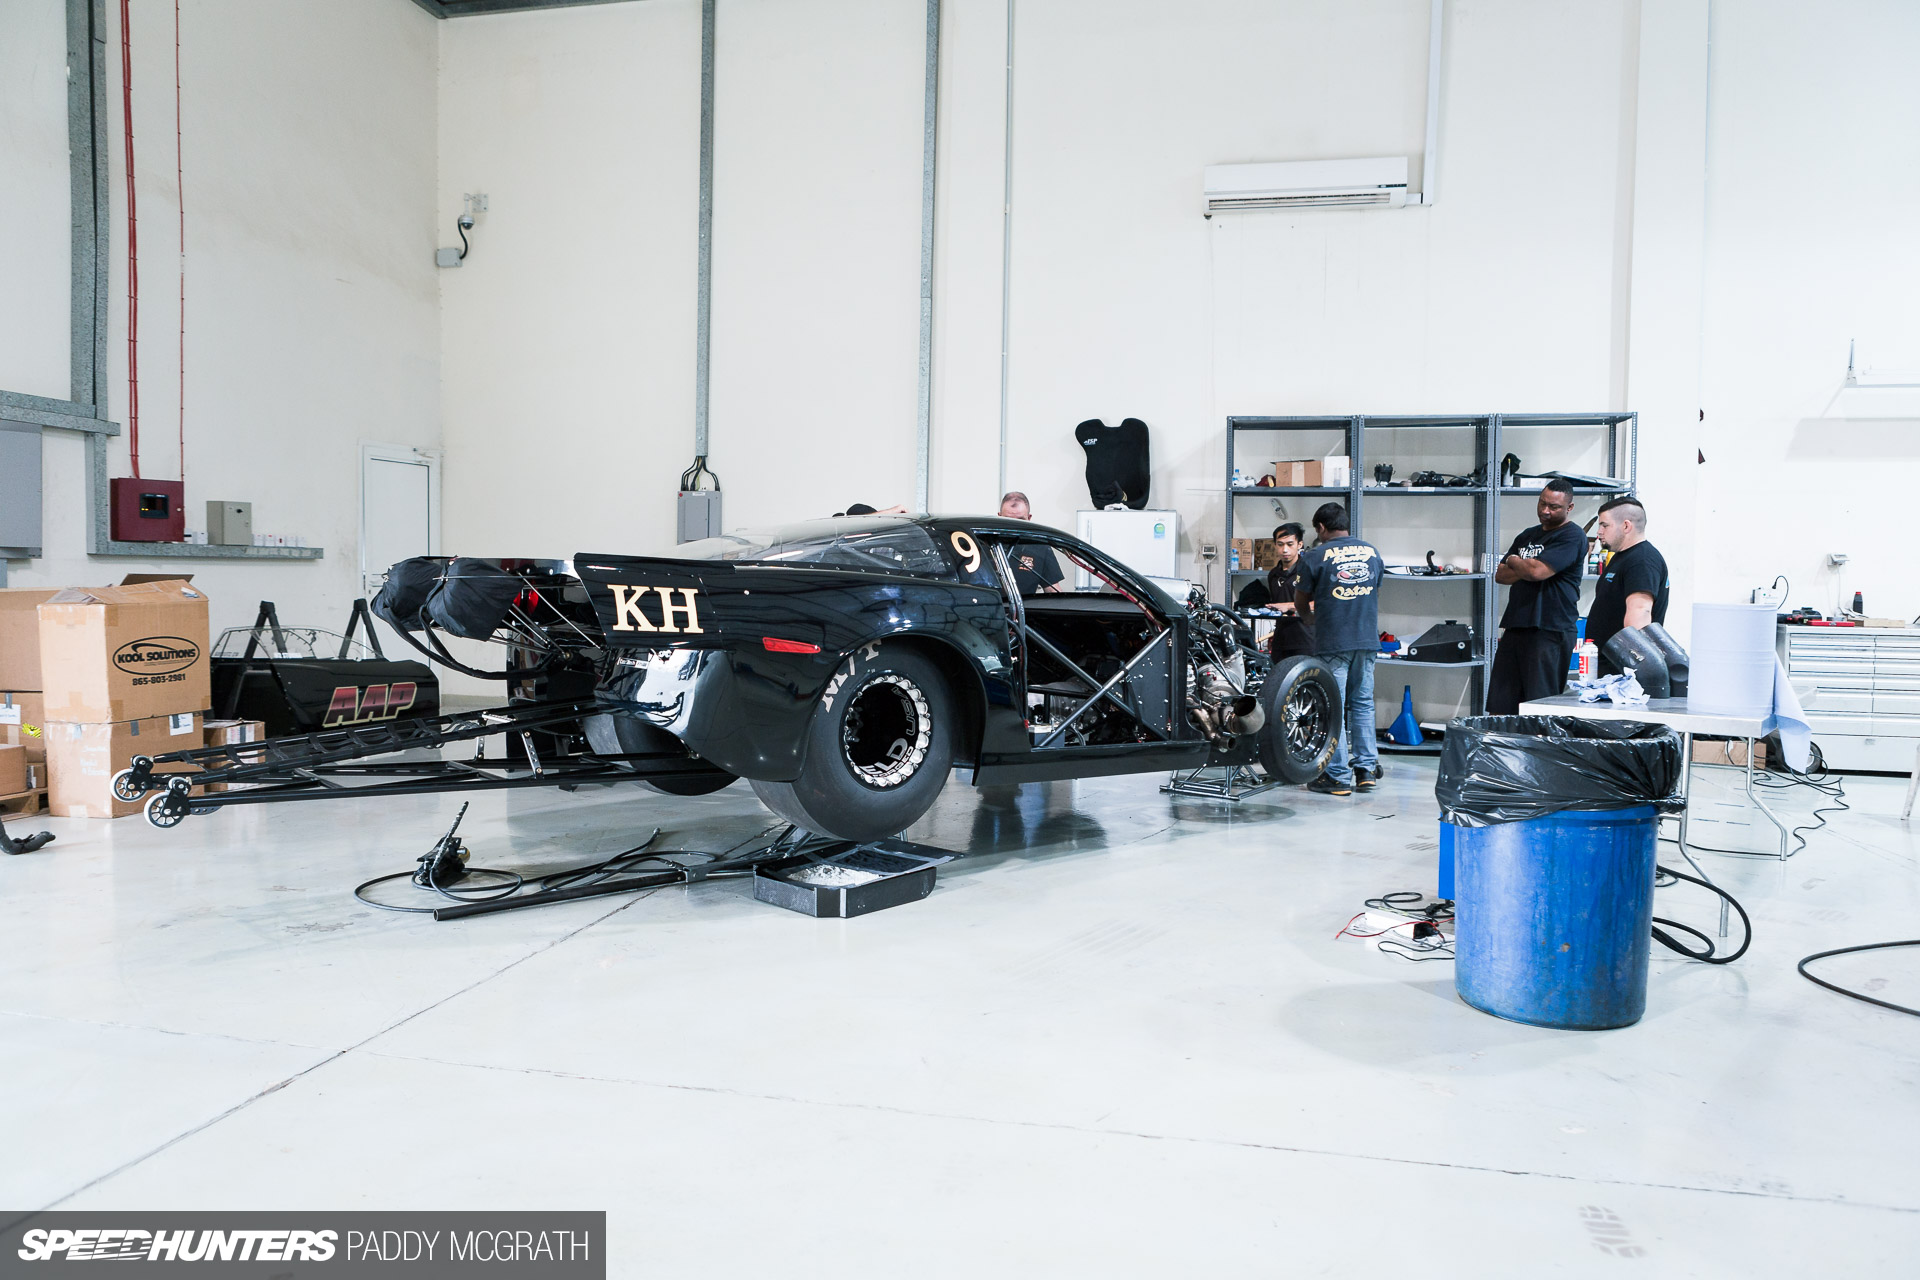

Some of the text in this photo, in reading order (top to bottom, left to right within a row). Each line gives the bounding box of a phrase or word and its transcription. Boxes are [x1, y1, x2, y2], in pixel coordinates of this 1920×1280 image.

[950, 531, 981, 574] 9
[606, 584, 705, 634] KH
[1332, 585, 1374, 600] Qatar
[117, 652, 145, 664] KOOL
[146, 648, 196, 662] SOLUTIONS
[322, 681, 418, 728] AAP
[1317, 737, 1338, 772] EAGLE
